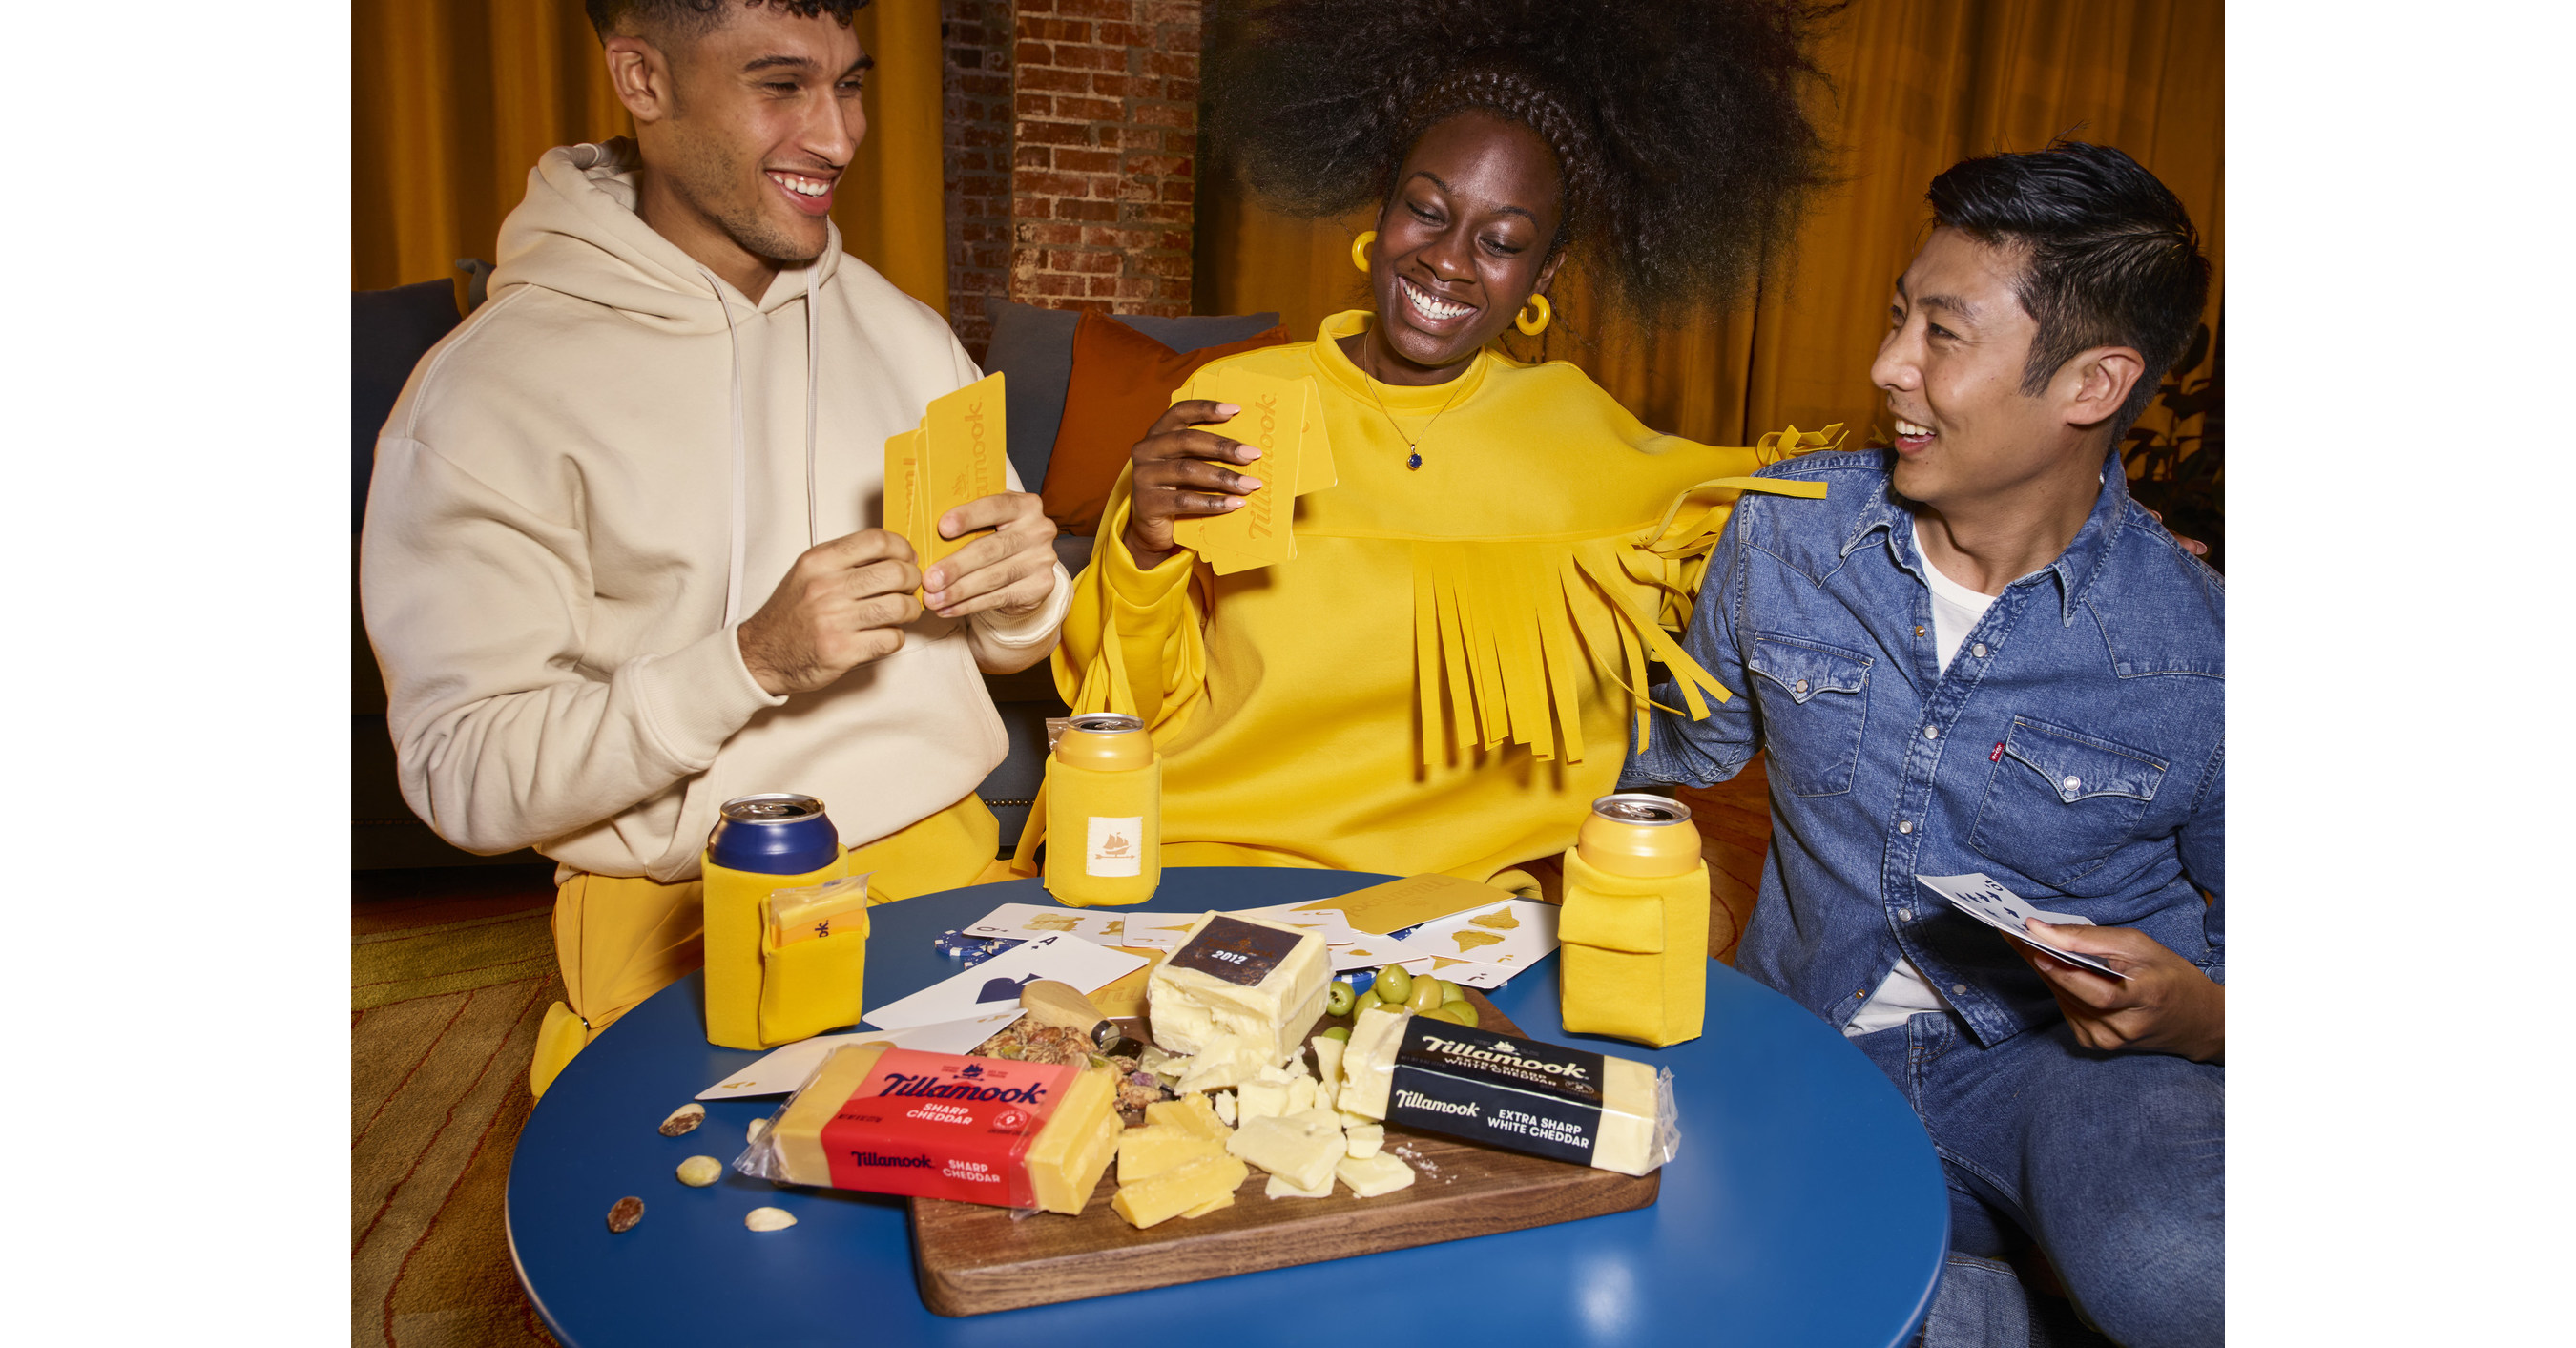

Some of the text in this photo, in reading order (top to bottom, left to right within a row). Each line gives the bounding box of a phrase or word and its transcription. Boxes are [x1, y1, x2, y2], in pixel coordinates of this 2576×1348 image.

[1249, 393, 1277, 540] Tillamook
[1039, 936, 1059, 946] A
[1211, 950, 1249, 964] 2012
[1422, 1035, 1587, 1079] Tillamook
[1444, 1057, 1488, 1071] WHITE
[1490, 1068, 1557, 1087] CHEDDAR
[879, 1073, 1047, 1104] Tillamook
[922, 1103, 969, 1115] SHARP
[1396, 1089, 1481, 1118] Tillamook
[905, 1110, 973, 1125] CHEDDAR
[1498, 1109, 1583, 1135] EXTRA SHARP
[1486, 1116, 1590, 1150] WHITE CHEDDAR
[850, 1151, 935, 1169] Tillamook
[948, 1159, 989, 1173] SHARP
[943, 1167, 1001, 1183] CHEDDAR
